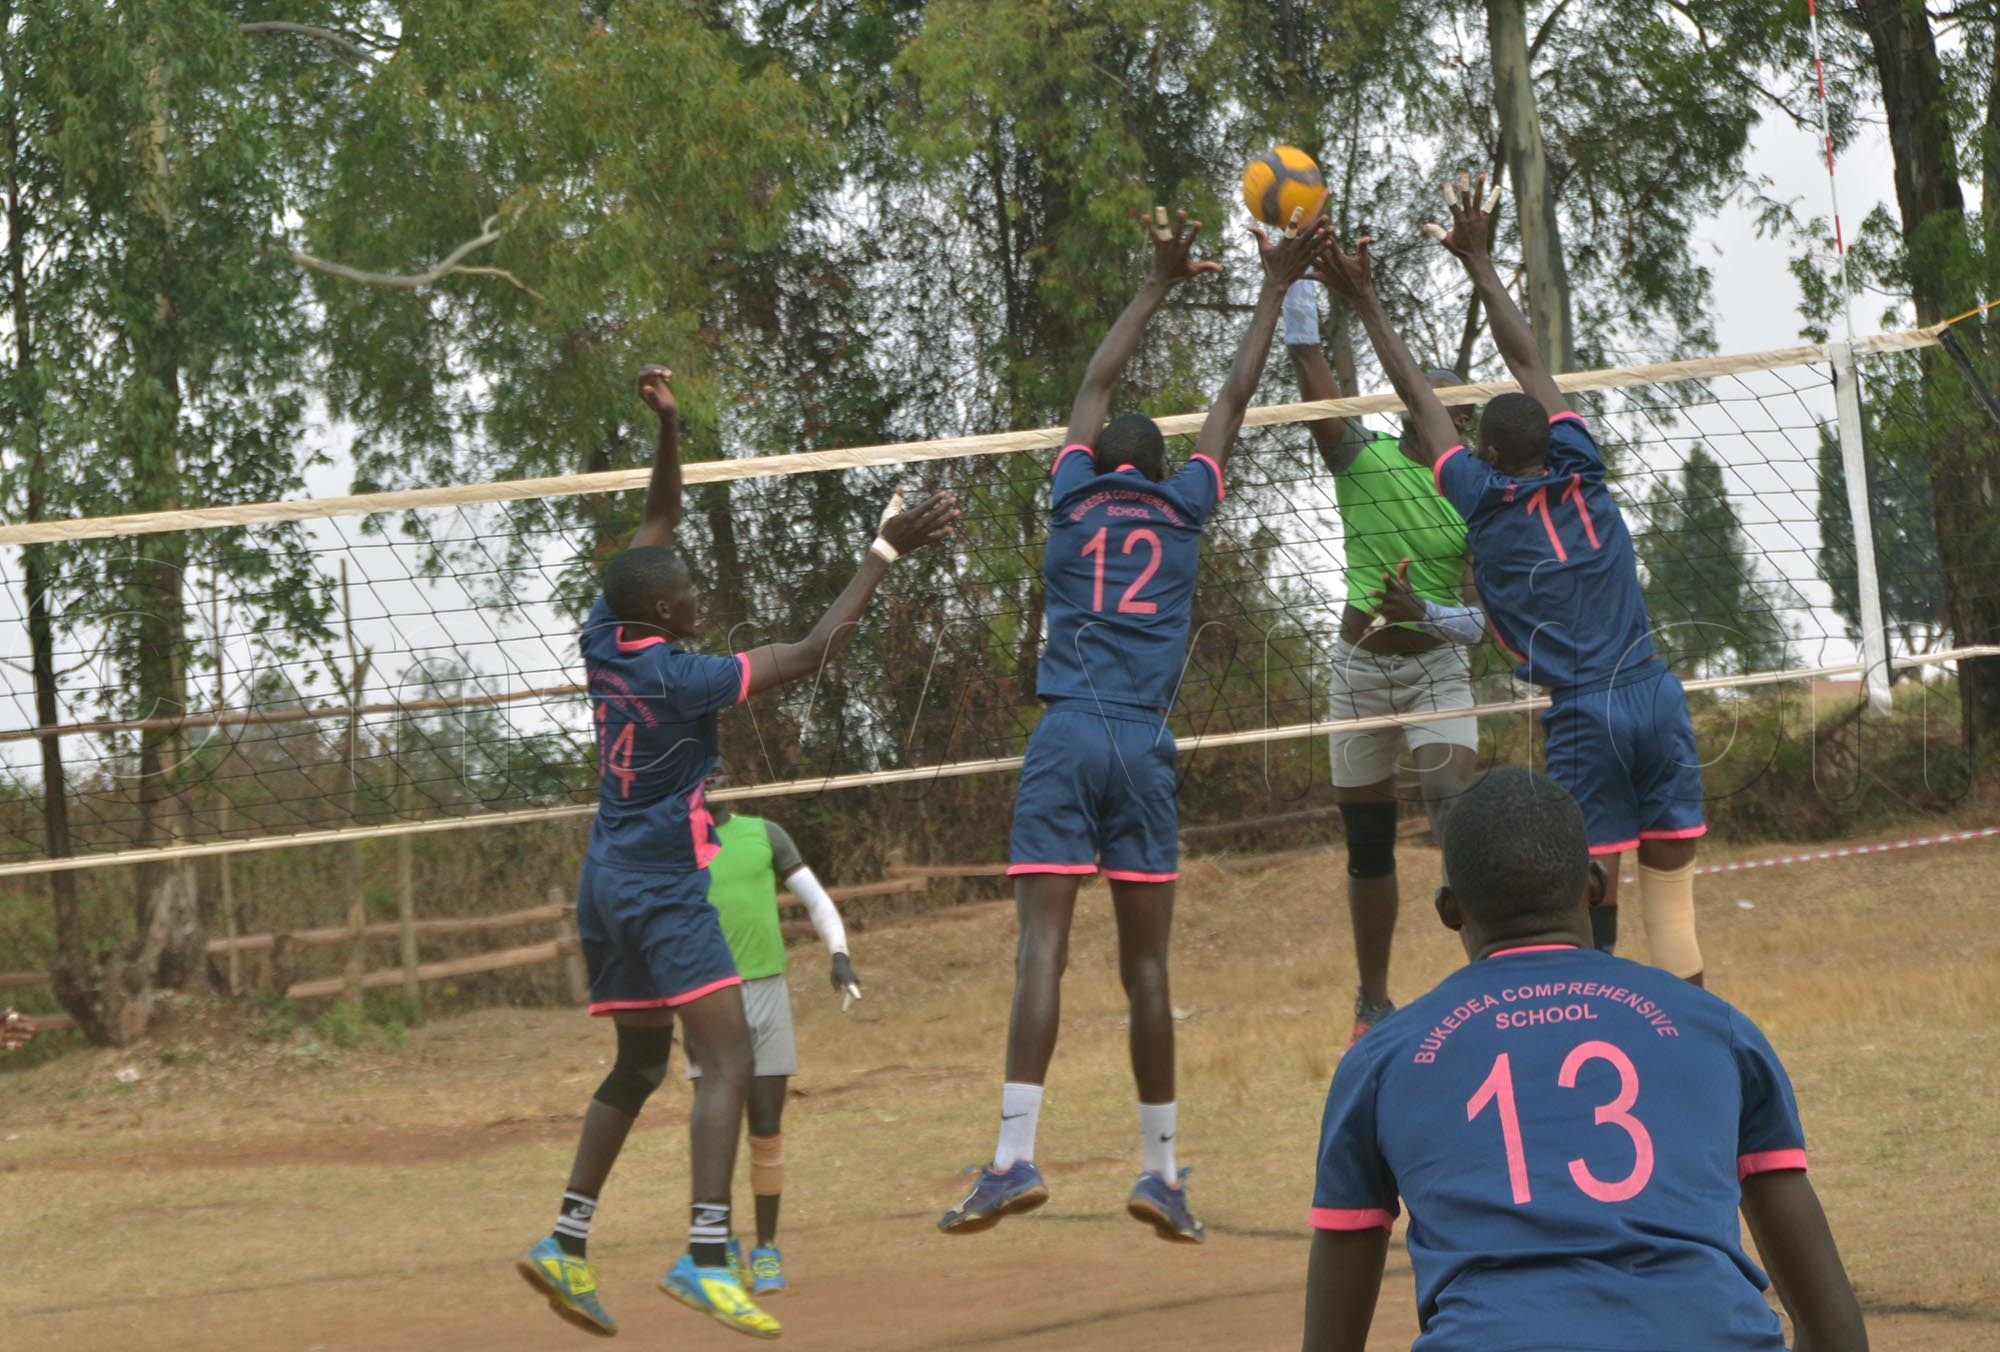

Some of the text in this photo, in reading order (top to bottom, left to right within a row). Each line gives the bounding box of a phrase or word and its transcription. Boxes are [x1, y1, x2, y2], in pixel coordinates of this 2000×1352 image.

[1106, 505, 1151, 519] SCHOOL
[1527, 472, 1602, 563] 11
[1081, 527, 1163, 614] 12
[595, 702, 637, 798] 14
[1413, 981, 1680, 1064] BUKEDEA COMPREHENSIVE
[1495, 1003, 1598, 1030] SCHOOL
[1466, 1040, 1655, 1204] 13
